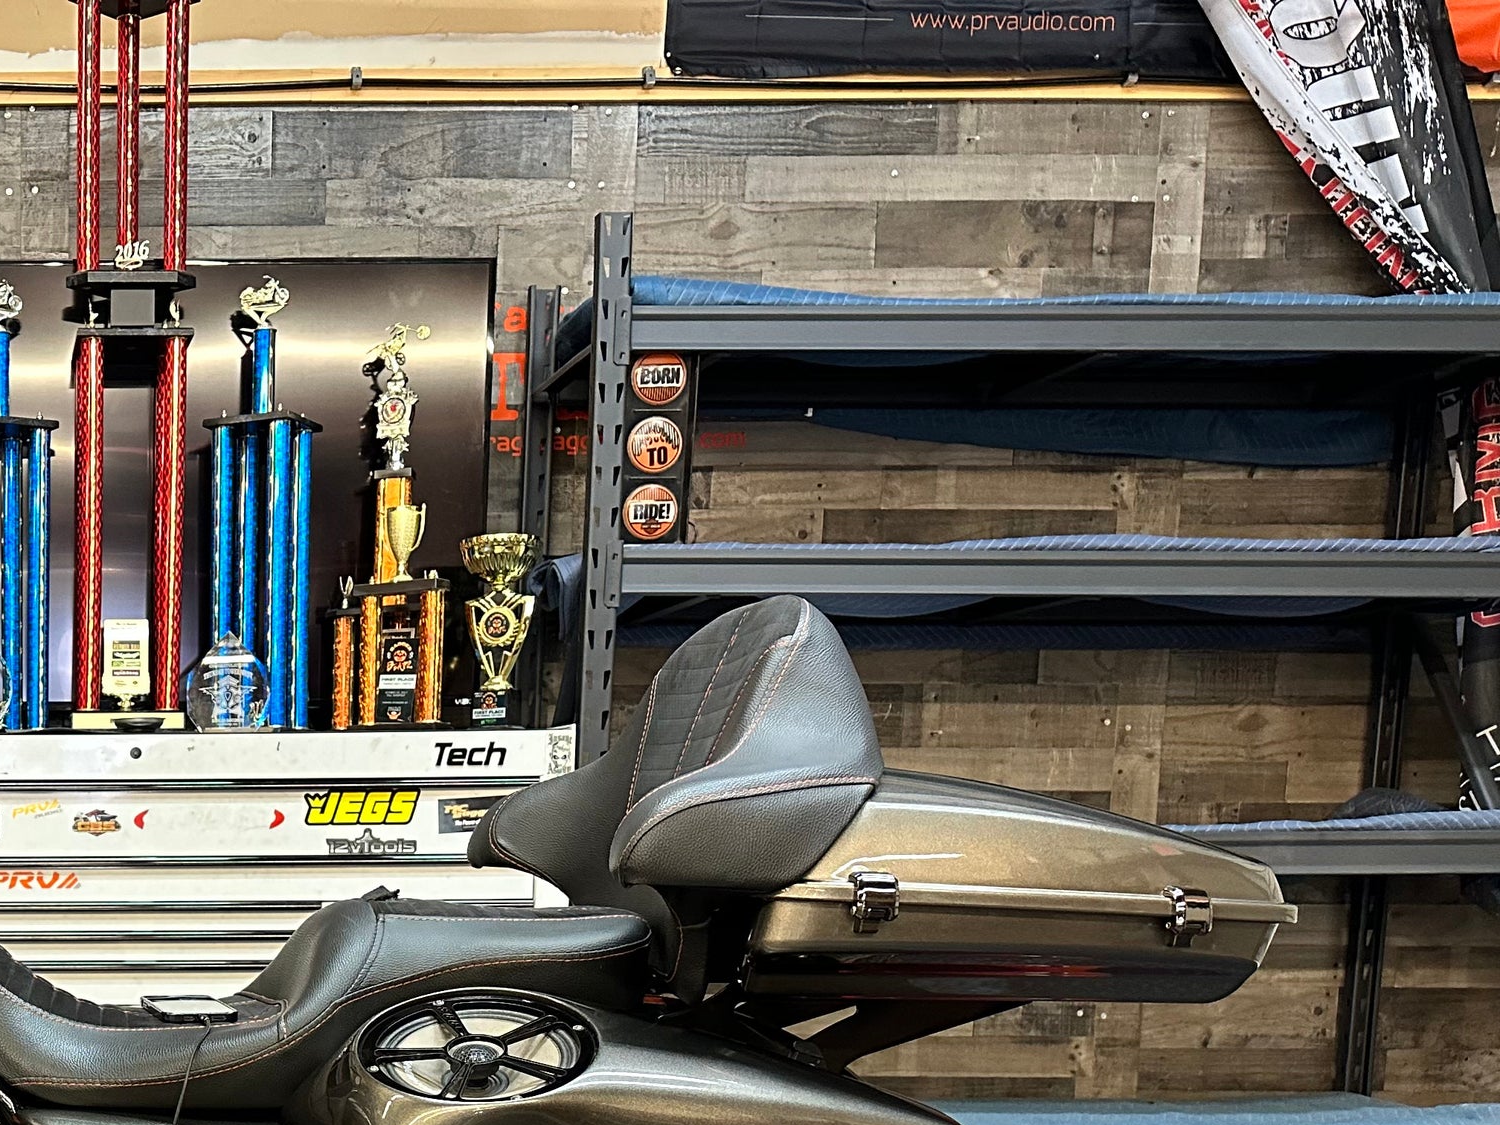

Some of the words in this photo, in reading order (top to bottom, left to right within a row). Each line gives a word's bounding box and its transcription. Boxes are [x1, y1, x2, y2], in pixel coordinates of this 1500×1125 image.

[910, 10, 1116, 37] www.prvaudio.com
[115, 240, 150, 261] 2016
[639, 366, 681, 385] BORN
[647, 446, 668, 466] TO
[633, 503, 671, 520] RIDE!
[434, 741, 508, 767] Tech
[306, 790, 419, 824] JEGS
